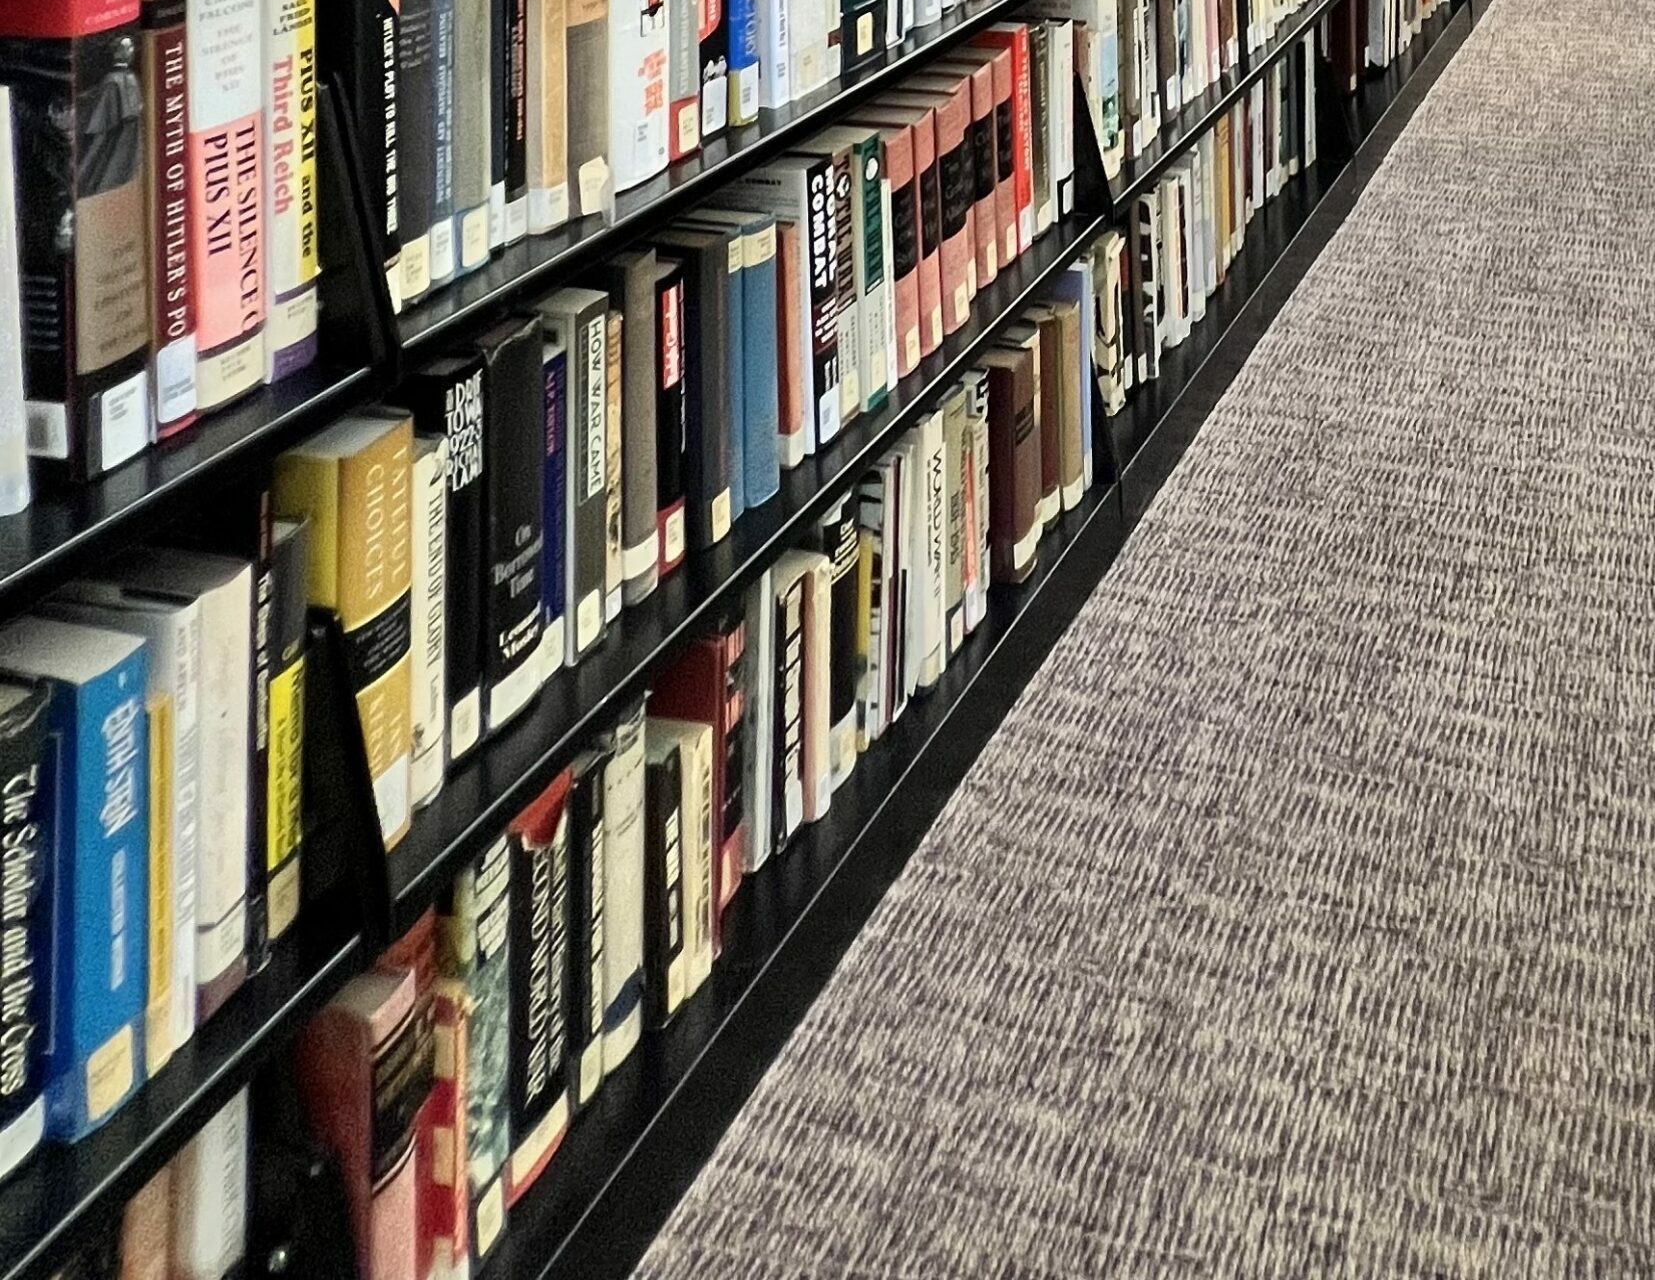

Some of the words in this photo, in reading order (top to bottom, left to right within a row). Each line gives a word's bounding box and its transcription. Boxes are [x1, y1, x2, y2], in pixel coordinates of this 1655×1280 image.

[163, 40, 184, 91] THE
[382, 16, 395, 68] HITLER'S
[272, 54, 295, 135] Third
[300, 48, 315, 113] PIUS
[383, 69, 396, 100] PLOT
[164, 98, 186, 158] MYTH
[384, 103, 397, 120] TO
[384, 120, 397, 149] KILL
[203, 132, 231, 201] PIUS
[235, 123, 257, 183] THE
[301, 120, 315, 163] XII
[385, 148, 398, 174] THE
[165, 162, 185, 199] OF
[273, 142, 295, 216] Reich
[301, 174, 315, 216] and
[205, 206, 233, 258] XII
[237, 183, 262, 317] SILENCE
[301, 220, 315, 259] the
[811, 173, 828, 289] COMBAT
[825, 164, 837, 282] MORAL
[166, 203, 188, 303] HITLER'S
[590, 320, 606, 372] HOW
[590, 376, 605, 434] WAR
[588, 437, 604, 493] CAME
[365, 463, 386, 601] CHOICES
[390, 446, 408, 584] FATEFUL
[427, 487, 445, 528] THE
[427, 529, 445, 577] END
[258, 570, 272, 604] The
[427, 577, 444, 601] OF
[426, 601, 444, 670] GLORY
[3, 763, 38, 825] The
[99, 765, 139, 840] STEIN
[2, 821, 39, 921] Scholar
[2, 924, 35, 977] and
[1, 976, 35, 1023] the
[528, 931, 549, 1042] WORLD
[1, 1022, 38, 1098] Cross
[526, 1031, 547, 1104] WAR
